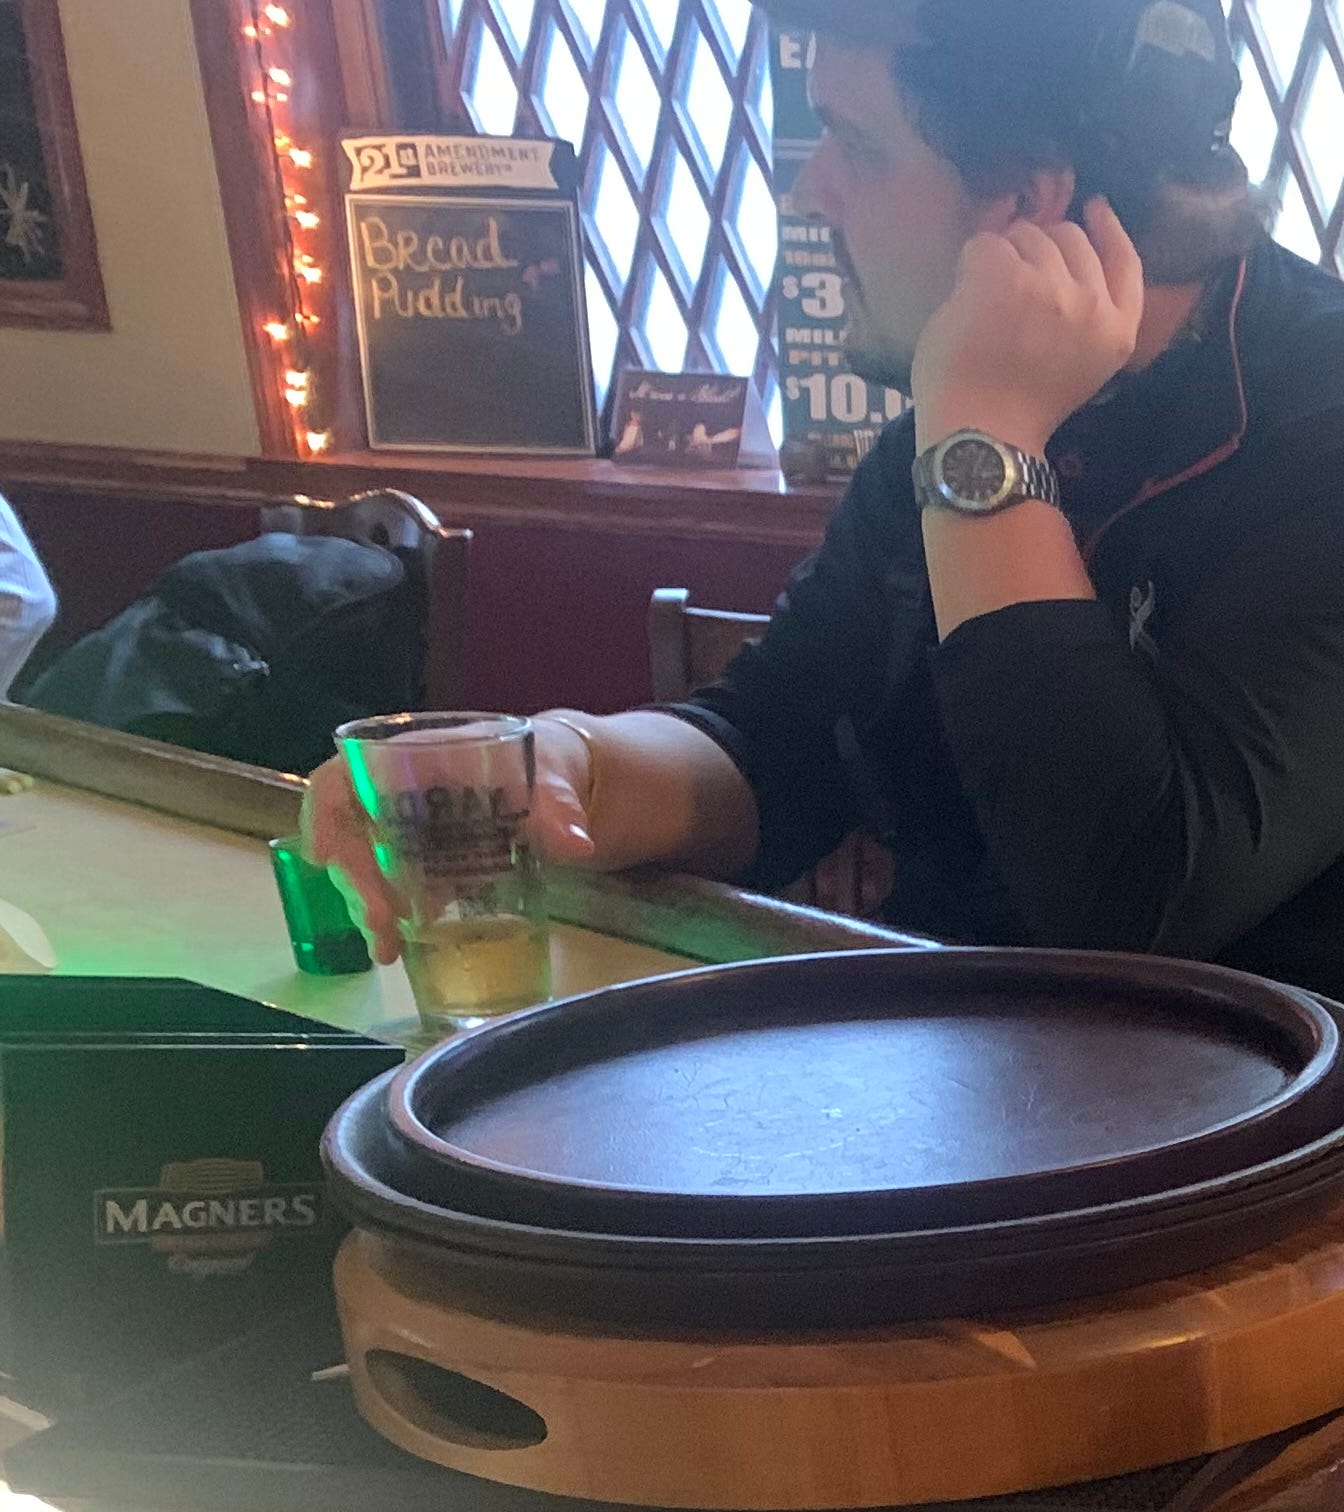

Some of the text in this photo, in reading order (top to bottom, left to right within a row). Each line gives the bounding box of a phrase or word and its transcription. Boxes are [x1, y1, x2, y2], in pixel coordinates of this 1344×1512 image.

[424, 143, 541, 161] AMENDMENT
[371, 271, 523, 336] Pudding
[105, 1194, 317, 1233] MAGNERS
